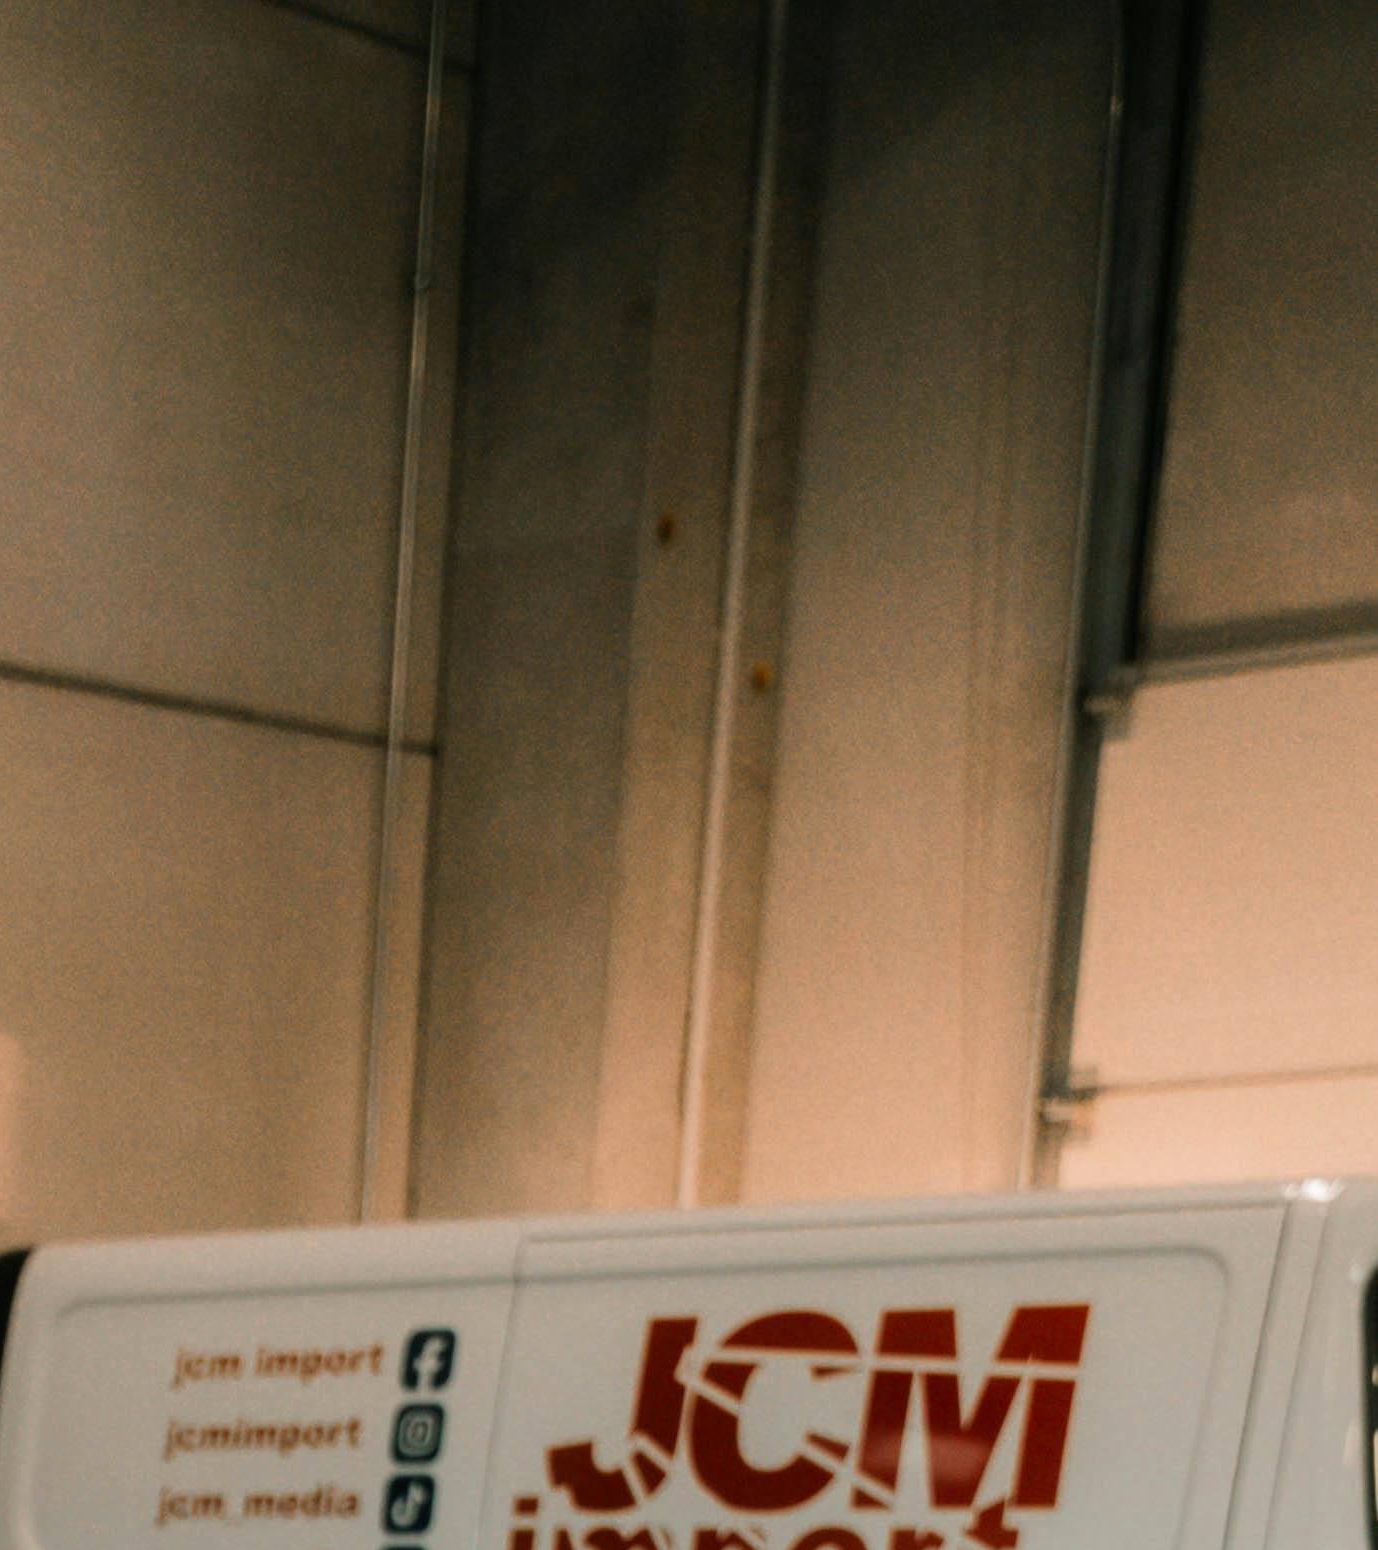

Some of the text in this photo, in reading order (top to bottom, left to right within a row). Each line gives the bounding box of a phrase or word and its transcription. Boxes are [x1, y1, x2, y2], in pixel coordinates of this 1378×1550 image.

[172, 1344, 385, 1394] jcm import
[546, 1304, 1091, 1513] JCM
[163, 1418, 363, 1462] jcmimport
